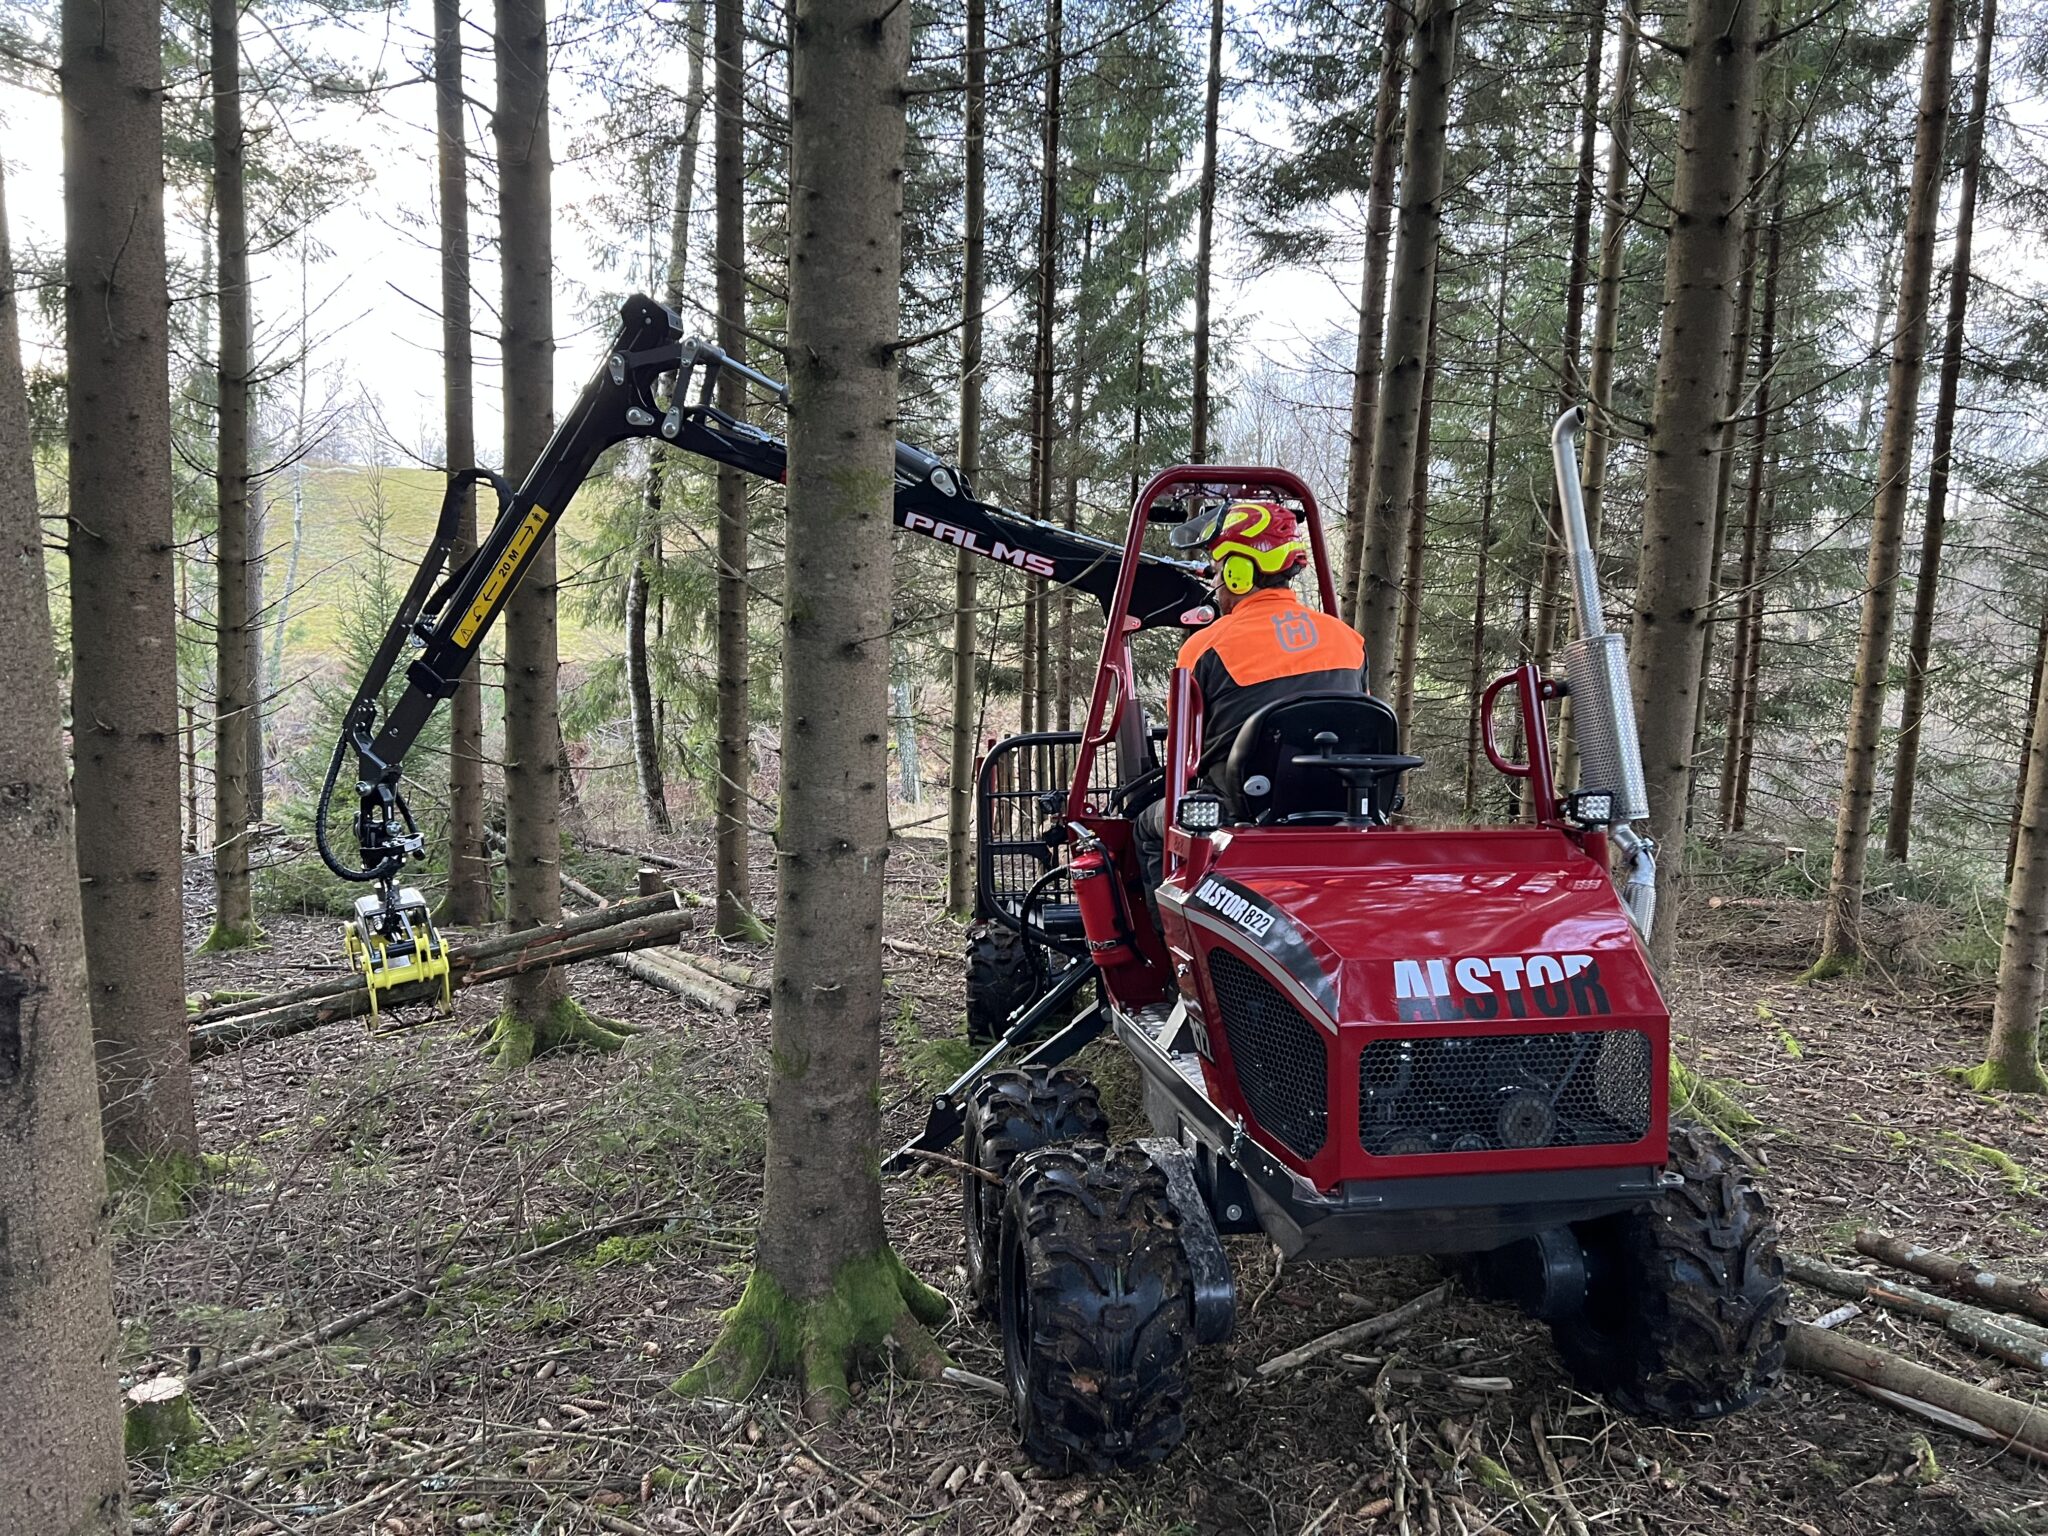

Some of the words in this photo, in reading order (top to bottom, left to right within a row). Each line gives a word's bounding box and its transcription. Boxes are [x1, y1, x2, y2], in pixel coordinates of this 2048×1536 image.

[498, 562, 511, 578] 20
[508, 548, 520, 562] M
[904, 511, 1056, 577] PALMS
[1393, 954, 1611, 1022] ALSTOR
